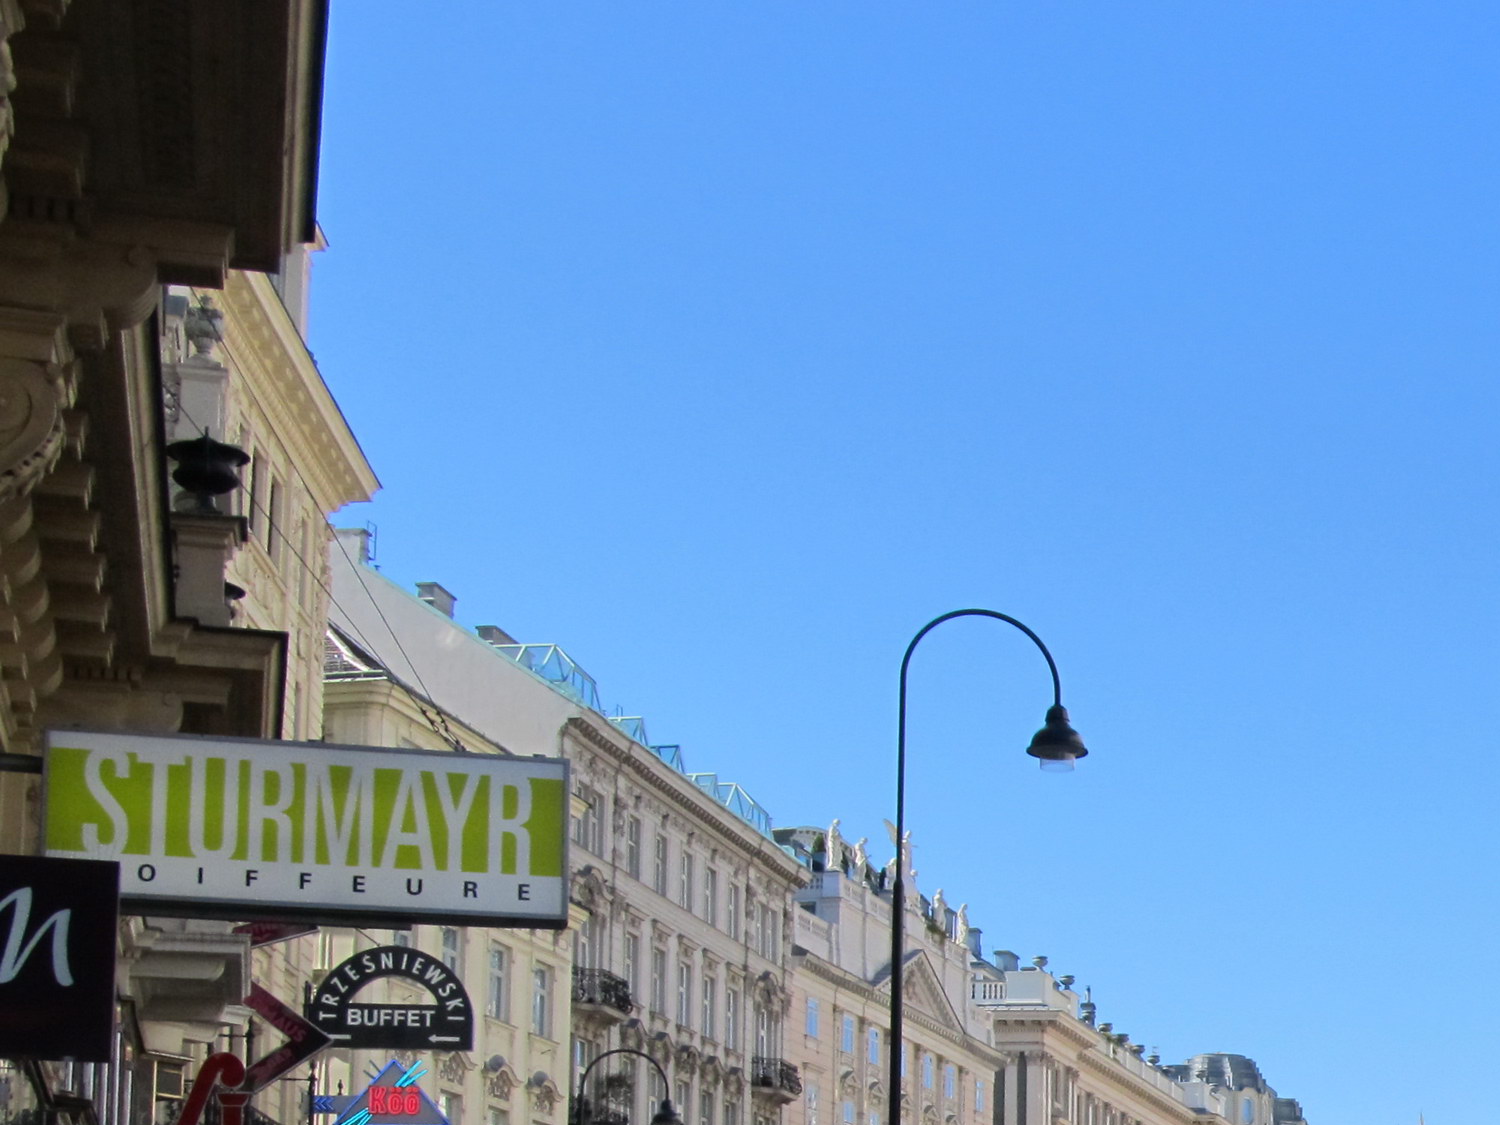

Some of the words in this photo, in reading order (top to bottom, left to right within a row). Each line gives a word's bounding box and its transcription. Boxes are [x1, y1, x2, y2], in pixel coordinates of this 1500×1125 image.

[81, 746, 535, 877] STURMAYR
[137, 863, 532, 902] OIFFEURE
[346, 1008, 436, 1028] BUFFET
[368, 1085, 421, 1115] Köö
